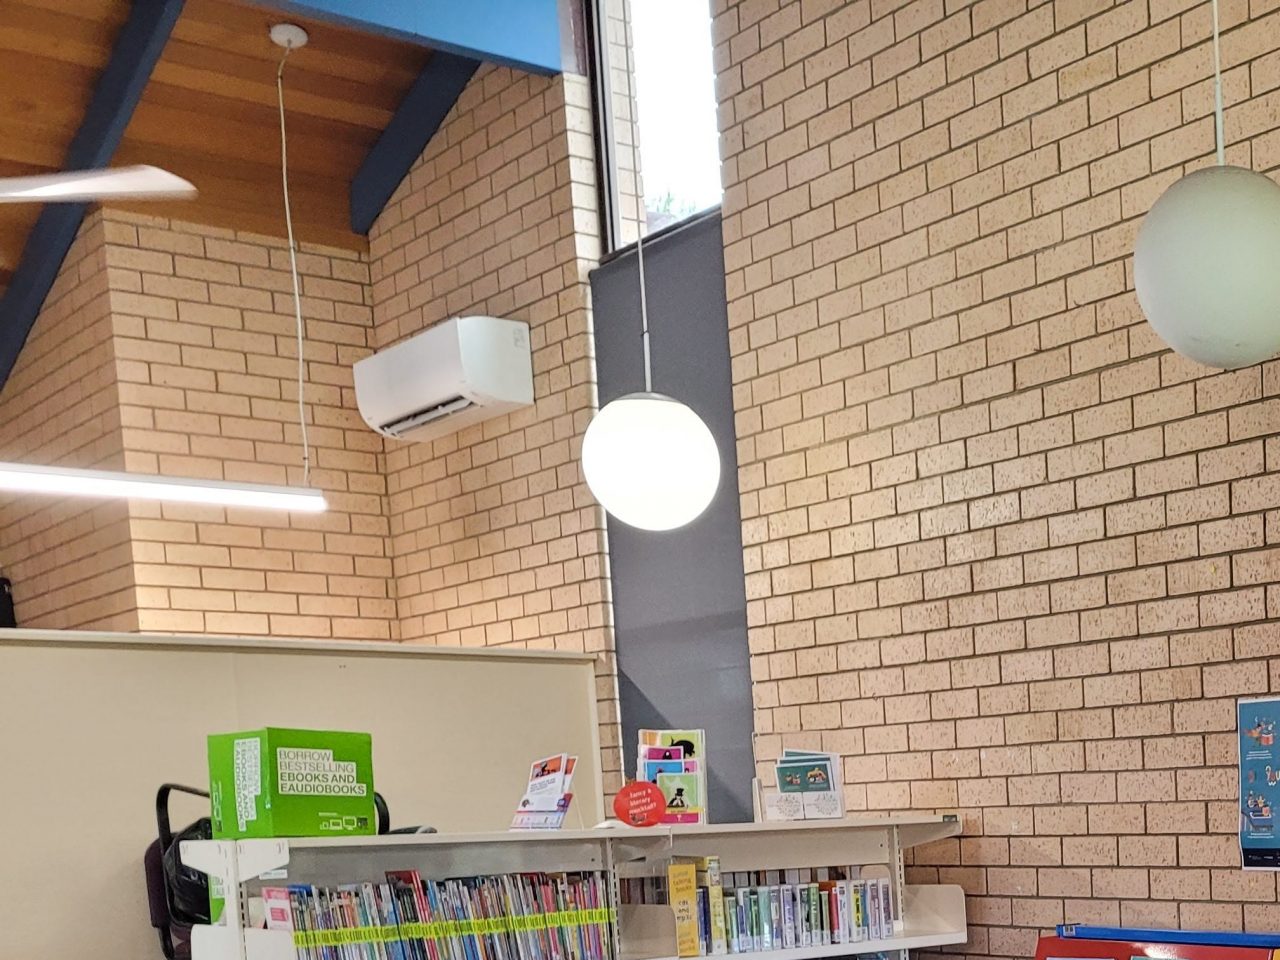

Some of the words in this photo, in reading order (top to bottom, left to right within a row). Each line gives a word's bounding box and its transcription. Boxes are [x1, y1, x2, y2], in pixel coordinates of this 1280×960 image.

[279, 751, 331, 762] BORROW
[279, 761, 355, 774] BESTSELLING
[280, 772, 329, 783] EBOOKS
[331, 774, 355, 784] AND
[281, 783, 366, 795] EAUDIOBOOKS
